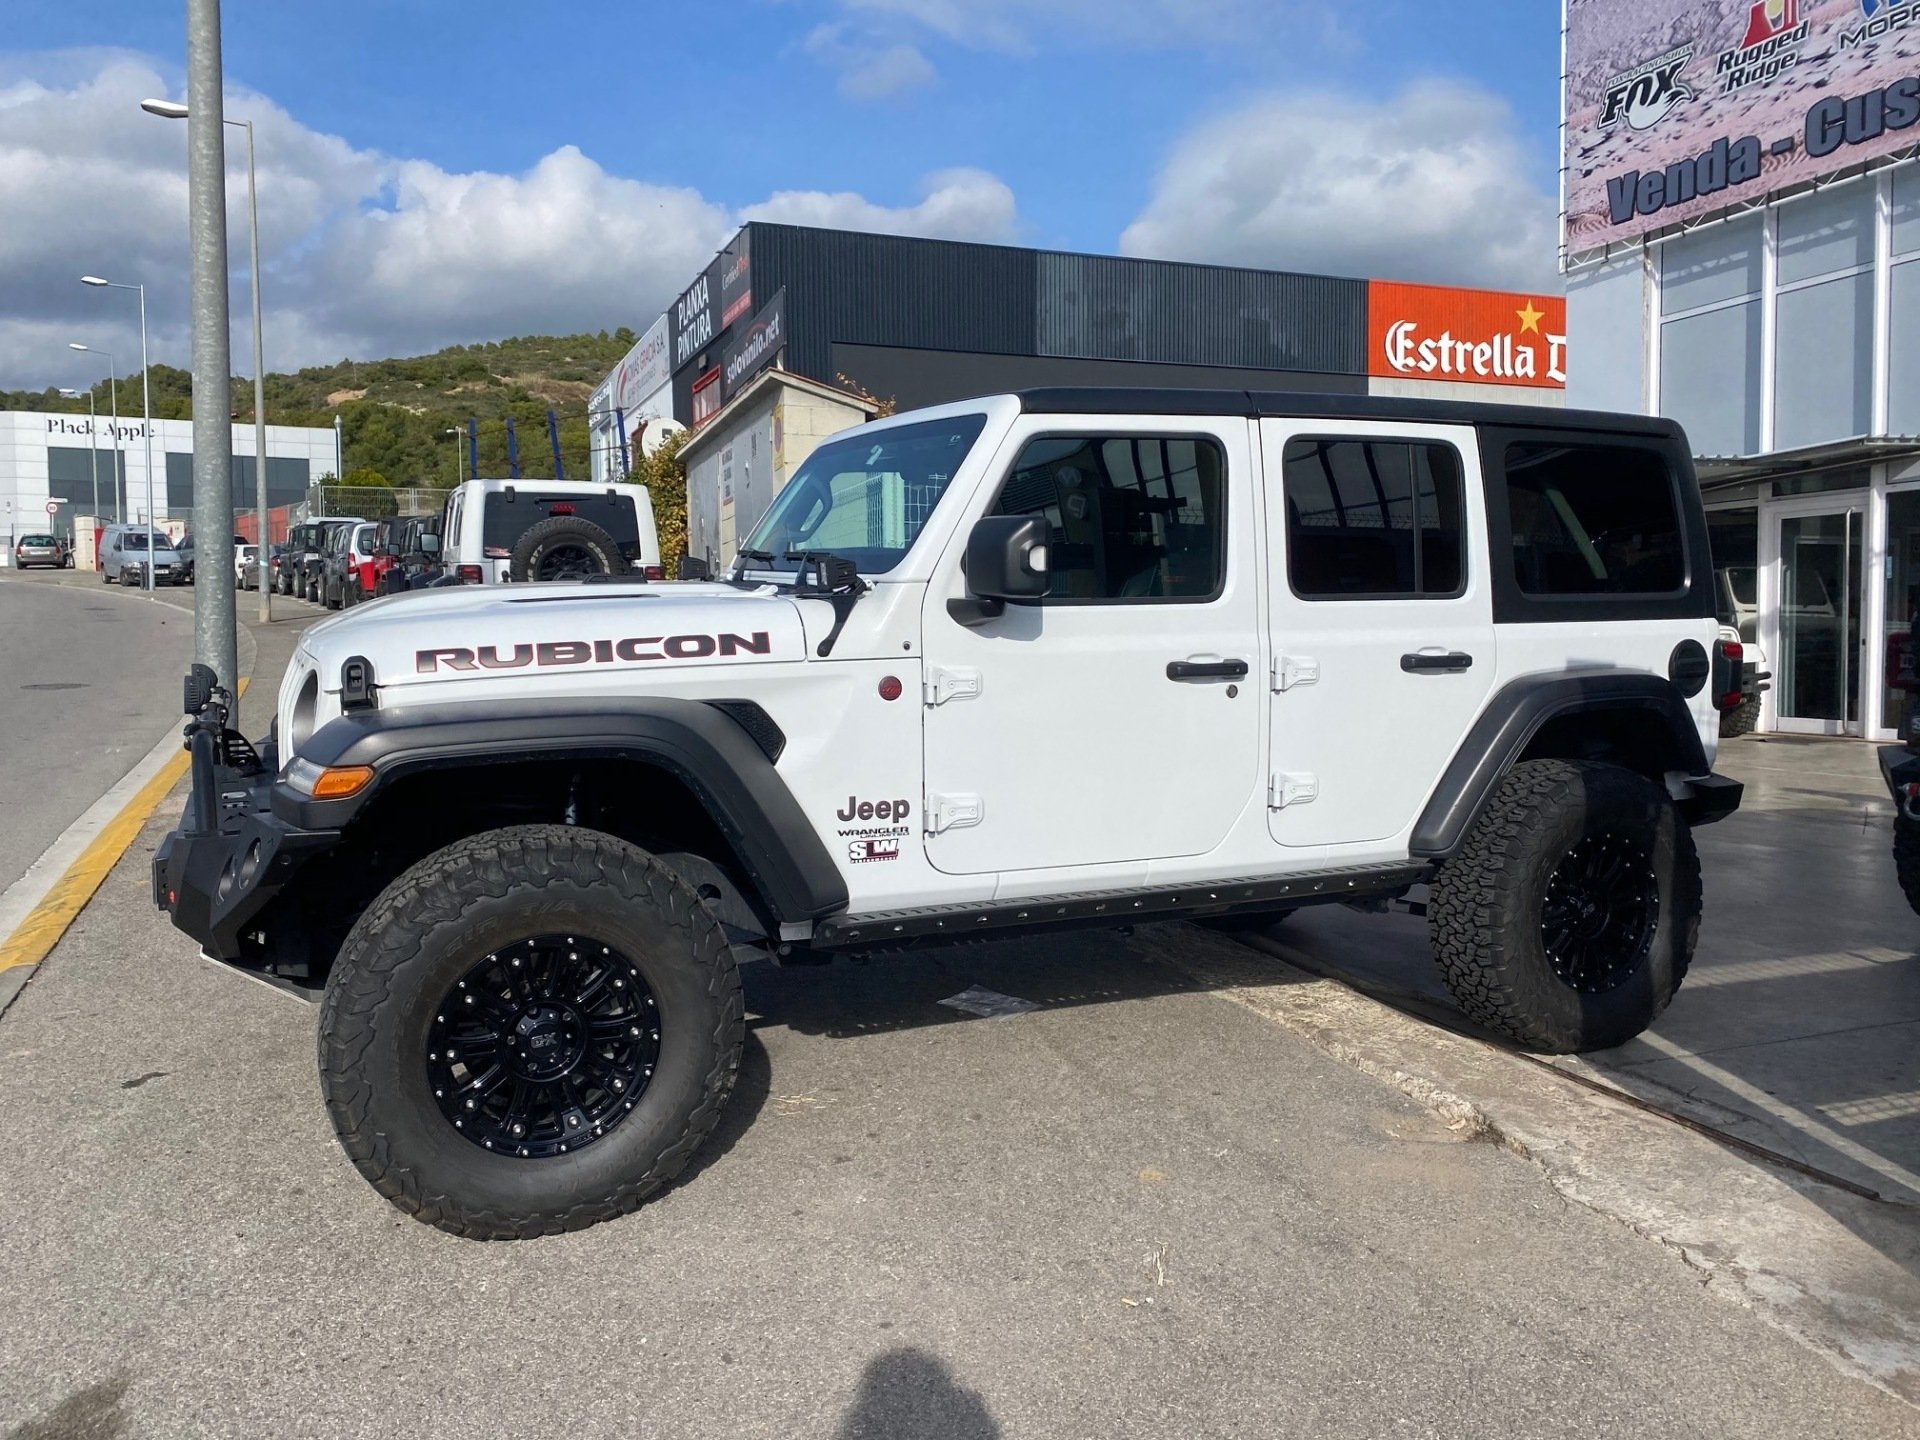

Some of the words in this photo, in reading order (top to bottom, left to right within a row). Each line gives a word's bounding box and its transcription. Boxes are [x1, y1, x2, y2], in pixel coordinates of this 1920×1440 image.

[1717, 20, 1809, 74] Rugged
[1726, 51, 1797, 92] Ridge
[1599, 57, 1689, 126] FOX
[1607, 135, 1762, 226] Venda
[678, 276, 709, 330] PLANXA
[678, 309, 712, 364] PINTURA
[727, 311, 780, 384] solovinilo.net
[1384, 319, 1536, 379] Estrella
[416, 632, 771, 673] RUBICON
[837, 796, 910, 823] Jeep
[837, 826, 910, 837] WRANGLER
